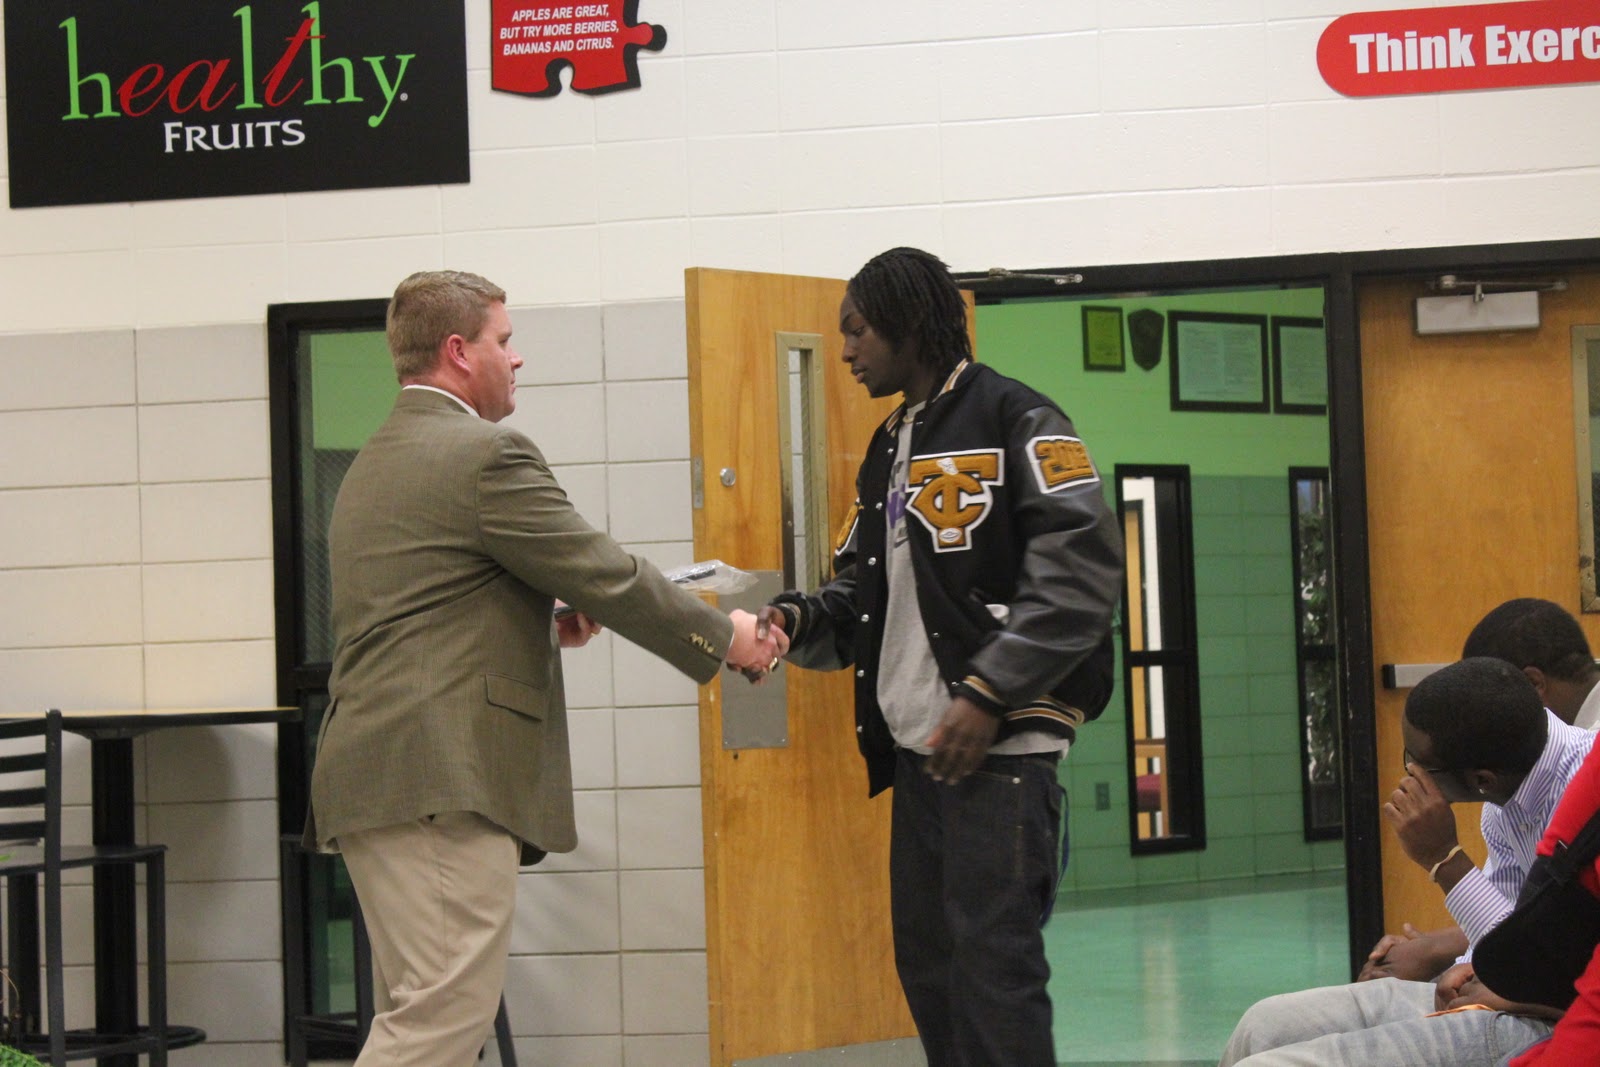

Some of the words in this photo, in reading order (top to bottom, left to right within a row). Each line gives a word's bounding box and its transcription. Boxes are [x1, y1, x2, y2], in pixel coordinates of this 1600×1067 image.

[512, 9, 551, 22] APPLES
[552, 7, 573, 19] ARE
[575, 4, 609, 18] GREAT,
[500, 27, 520, 40] BUT
[522, 25, 541, 38] TRY
[543, 24, 573, 36] MORE
[574, 20, 619, 35] BERRIES,
[503, 41, 551, 56] BANANAS
[553, 40, 574, 52] AND
[576, 37, 614, 50] CITRUS.
[1349, 28, 1476, 74] Think
